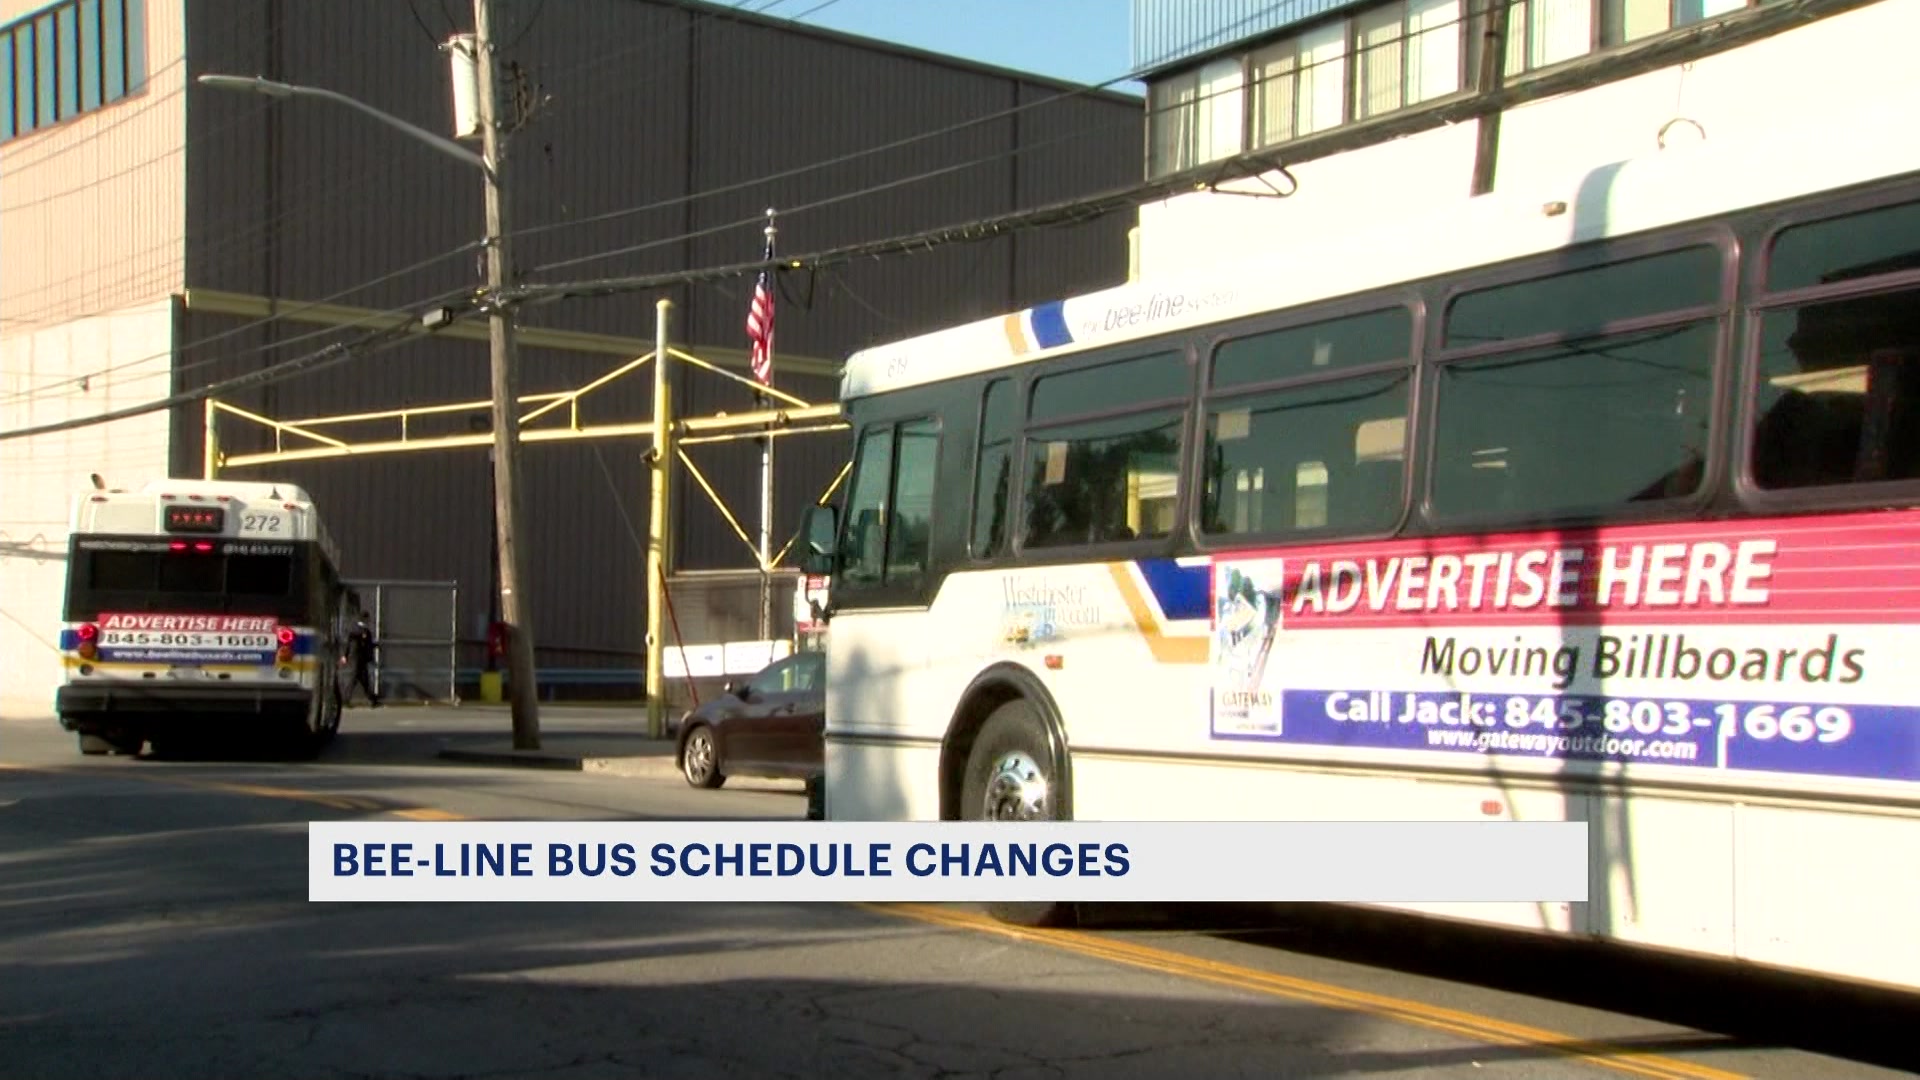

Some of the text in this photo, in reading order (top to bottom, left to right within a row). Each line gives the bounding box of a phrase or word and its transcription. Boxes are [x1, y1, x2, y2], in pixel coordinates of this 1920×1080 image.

[1103, 292, 1184, 331] bee-line
[243, 515, 281, 533] 272
[1292, 539, 1777, 614] ADVERTISE HERE
[105, 615, 277, 631] ADVERTISE HERE
[105, 632, 269, 647] 845-803-1669
[1419, 634, 1866, 690] Moving Billboards
[1325, 691, 1852, 743] Call Jack: 845-803-1669
[1427, 725, 1698, 761] www.gatewayoutdoor.com
